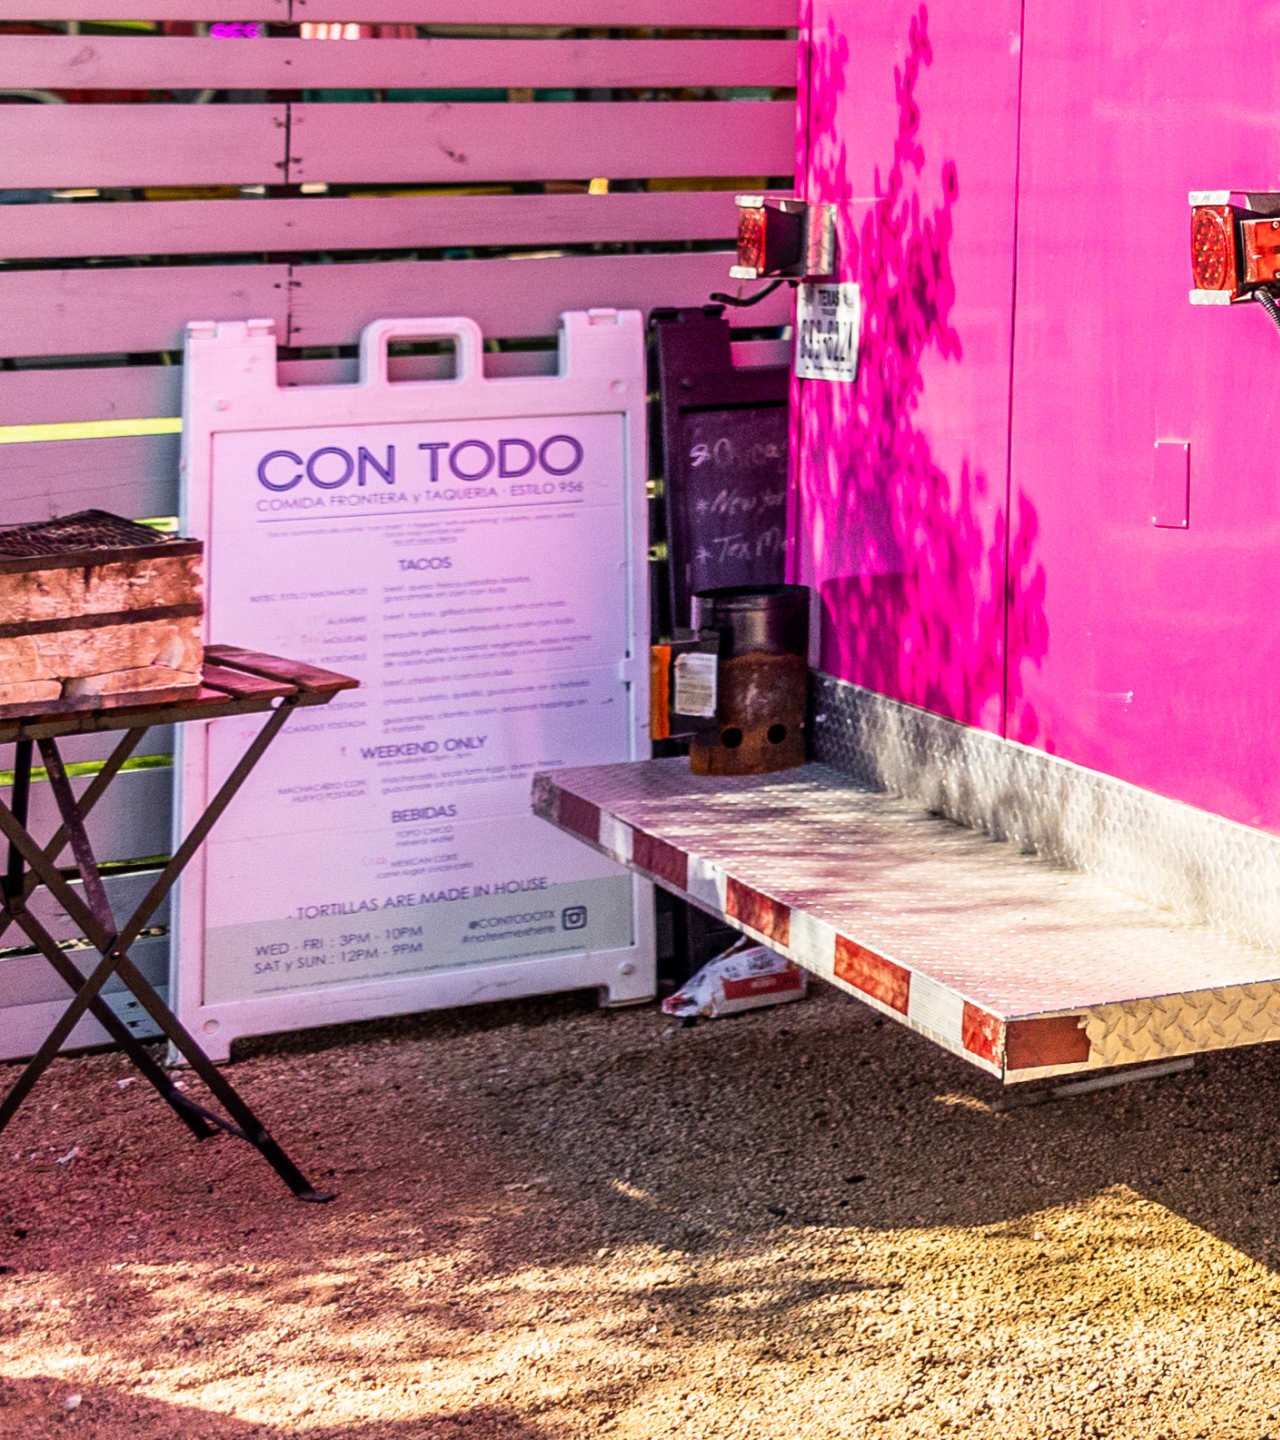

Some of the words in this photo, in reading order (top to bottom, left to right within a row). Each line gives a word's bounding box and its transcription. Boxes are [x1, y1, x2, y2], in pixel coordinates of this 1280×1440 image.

[257, 445, 395, 492] CON
[418, 434, 584, 482] TODO
[256, 497, 325, 512] COMIDA
[330, 491, 408, 507] FRONTERA
[425, 487, 498, 502] TAQUERIA
[510, 482, 555, 497] ESTILO
[398, 556, 452, 571] TACOS
[360, 741, 439, 759] WEEKEND
[444, 735, 488, 752] ONLY
[391, 804, 458, 823] BEBIDAS
[297, 898, 379, 920] TORTILLAS
[384, 893, 416, 909] ARE
[420, 886, 470, 904] MADE
[473, 884, 491, 897] IN
[494, 877, 548, 895] HOUSE
[255, 942, 290, 956] WED
[303, 938, 324, 951] FRI
[339, 933, 371, 947] 3PM
[385, 926, 424, 940] 10PM
[254, 960, 281, 975] SAT
[297, 954, 327, 969] SUN
